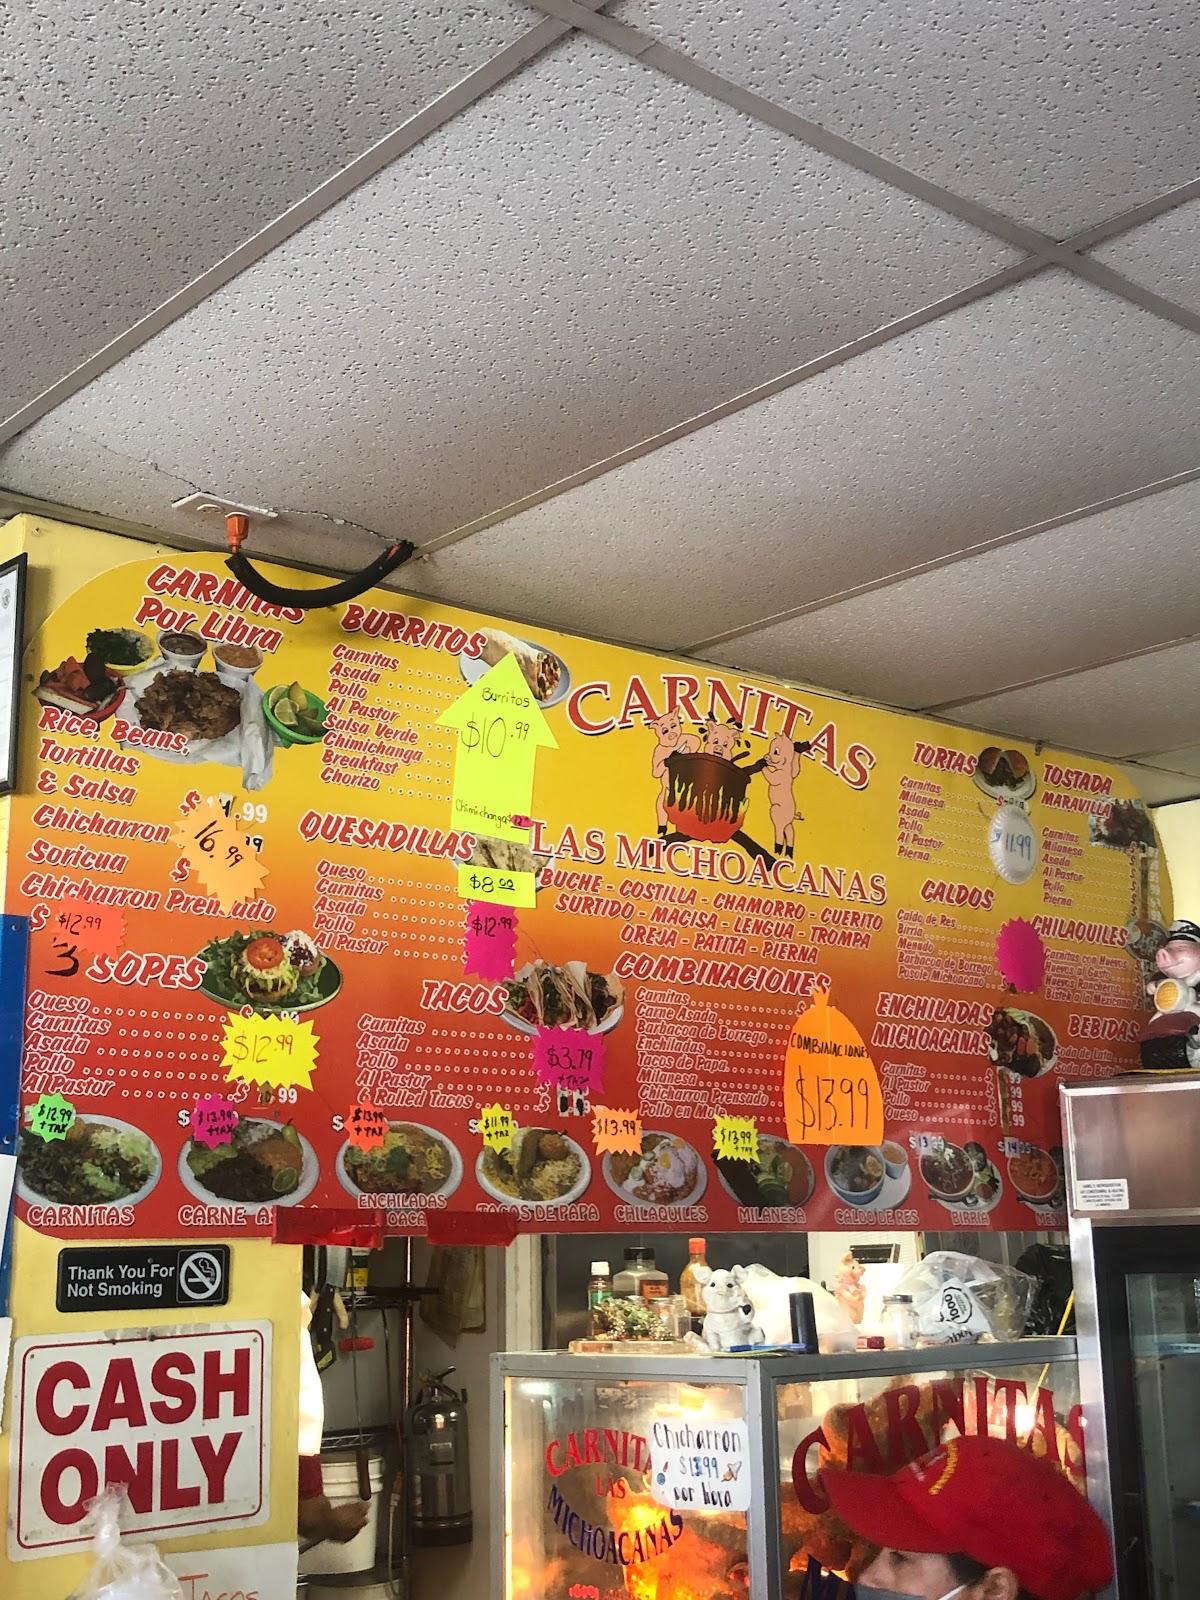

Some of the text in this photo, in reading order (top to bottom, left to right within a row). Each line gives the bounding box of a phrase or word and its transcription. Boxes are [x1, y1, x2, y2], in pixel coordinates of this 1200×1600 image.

[146, 564, 305, 623] CARNITAS
[135, 596, 284, 653] Por Libra
[341, 603, 488, 658] BURRITOS
[332, 643, 400, 671] Carnitas
[329, 660, 382, 685] Asada
[327, 678, 369, 700] Pollo
[482, 687, 531, 708] Burritos
[325, 695, 400, 723] Al Pastor
[38, 706, 190, 755] Rice, Beans,
[323, 713, 419, 745] Salsa Verde
[460, 713, 531, 758] $10.99
[566, 674, 876, 789] CARNITAS
[38, 738, 140, 775] Tortillas
[322, 730, 424, 764] Chimichanga
[321, 749, 401, 775] Breakfast
[912, 742, 977, 777] TORTAS
[37, 769, 137, 806] & Salsa
[320, 766, 381, 791] Chorizo
[899, 775, 942, 795] Carnitas
[1041, 764, 1113, 795] TOSTADA
[898, 789, 946, 809] Milanesa
[1040, 791, 1112, 820] MARAVILLA
[32, 803, 171, 843] Chicharron
[898, 804, 931, 819] Asada
[299, 810, 478, 862] QUESADILLAS
[898, 817, 924, 832] Pollo
[1042, 827, 1080, 844] Carnitas
[911, 833, 944, 850] Pastor
[1042, 840, 1085, 857] Milanesa
[27, 838, 128, 873] Soricua
[531, 820, 888, 904] LAS MICHOACANAS
[897, 846, 931, 862] Pierna
[1042, 854, 1072, 867] Asada
[317, 859, 367, 881] Queso
[1054, 868, 1085, 882] Pastor
[20, 872, 162, 911] Chicharron
[315, 878, 385, 901] Carnitas
[920, 879, 995, 911] CALDOS
[1043, 879, 1065, 893] Pollo
[314, 896, 368, 917] Asada
[538, 868, 885, 932] BUCHE COSTILLA CHAMORRO CUERITO
[1043, 892, 1073, 907] Pierna
[57, 912, 103, 937] $12.99
[314, 914, 354, 934] Pollo
[472, 915, 513, 938] $12.99
[555, 893, 873, 950] SURTIDO MACISA LENGUA TROMPA
[897, 908, 957, 929] Caldo de Res
[897, 922, 923, 937] Birria
[1031, 914, 1128, 949] CHILAQUILES
[313, 931, 389, 956] Al Pastor
[620, 924, 821, 965] OREJA PATITA PIERNA
[897, 936, 934, 953] Menudo
[86, 950, 208, 990] SOPES
[897, 951, 994, 976] Barbacoa Borrego
[1045, 947, 1129, 970] Carnitas Huevos
[614, 951, 832, 997] COMBINACIONES
[898, 965, 985, 988] Posole Michoacano
[1045, 975, 1121, 994] Huevos Rancheros
[28, 989, 92, 1015] Queso
[420, 980, 509, 1015] TACOS
[635, 986, 691, 1006] Carnitas
[635, 1002, 718, 1024] Carne Asada
[876, 992, 994, 1027] ENCHILADAS
[26, 1011, 112, 1036] Carnitas
[358, 1013, 427, 1036] Carnitas
[635, 1018, 768, 1048] Barbacoa de Borrego
[1067, 1014, 1140, 1043] BEBIDAS
[24, 1031, 91, 1055] Asada
[232, 1030, 294, 1064] $12.99
[356, 1032, 411, 1053] Asada
[635, 1035, 706, 1056] Enchiladas
[871, 1022, 990, 1057] MICHOACANAS
[23, 1051, 76, 1076] Pollo
[356, 1050, 400, 1071] Pollo
[547, 1044, 594, 1072] $3.79
[637, 1051, 675, 1069] Tacos
[675, 1054, 694, 1071] de
[1055, 1045, 1078, 1060] Soda
[355, 1068, 433, 1090] Al Pastor
[636, 1067, 698, 1087] Milanesa
[880, 1060, 927, 1078] Carnitas
[1054, 1061, 1079, 1076] Soda
[21, 1072, 117, 1097] Al Pastor
[638, 1083, 769, 1107] Chicharron Prensado
[881, 1076, 931, 1092] Al Pastor
[373, 1088, 475, 1109] Rolled Tacos
[639, 1101, 692, 1119] Pollo en
[795, 1065, 871, 1141] $13.99
[883, 1091, 910, 1107] Pollo
[885, 1107, 919, 1122] Queso
[48, 1123, 68, 1133] TAX
[364, 1126, 383, 1138] TAX
[358, 1192, 448, 1210] ENCHILADAS
[28, 1204, 135, 1227] CARNITAS
[178, 1204, 246, 1227] CARNE
[534, 1204, 600, 1222] DE PAPA
[614, 1204, 709, 1224] CHILAQUILES
[738, 1206, 807, 1225] MILANESA
[834, 1208, 920, 1226] CALDO DE RES
[951, 1210, 992, 1227] BIRRIA
[69, 1264, 175, 1282] Thank You For
[67, 1281, 163, 1300] Not Smoking
[35, 1347, 251, 1437] CASH
[653, 1421, 742, 1453] Chicharron
[40, 1431, 243, 1526] ONLY
[594, 1474, 626, 1499] LAS
[547, 1484, 684, 1566] MICHOACANAS
